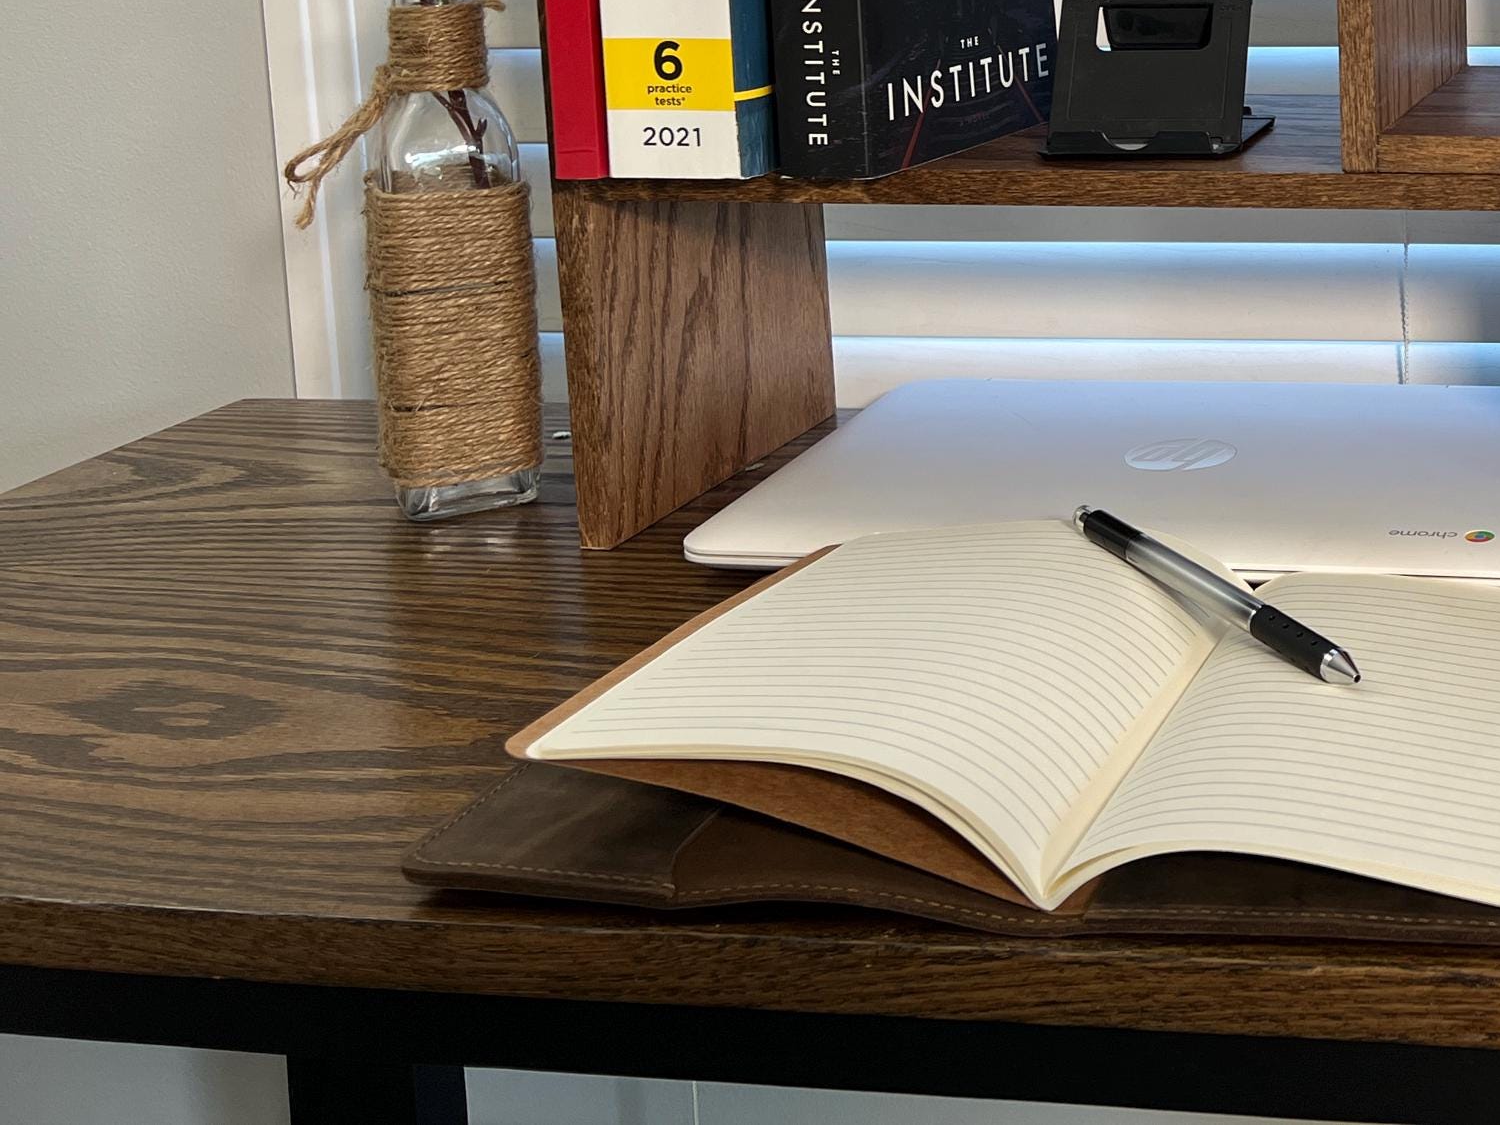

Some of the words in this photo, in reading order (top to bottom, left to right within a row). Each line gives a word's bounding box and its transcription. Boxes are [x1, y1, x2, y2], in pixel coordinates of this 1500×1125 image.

[960, 36, 979, 49] THE
[654, 41, 683, 81] 6
[832, 50, 840, 75] THE
[647, 84, 692, 95] practice
[887, 43, 1049, 121] INSTITUTE
[643, 127, 701, 147] 2021
[1388, 529, 1458, 540] chrome
